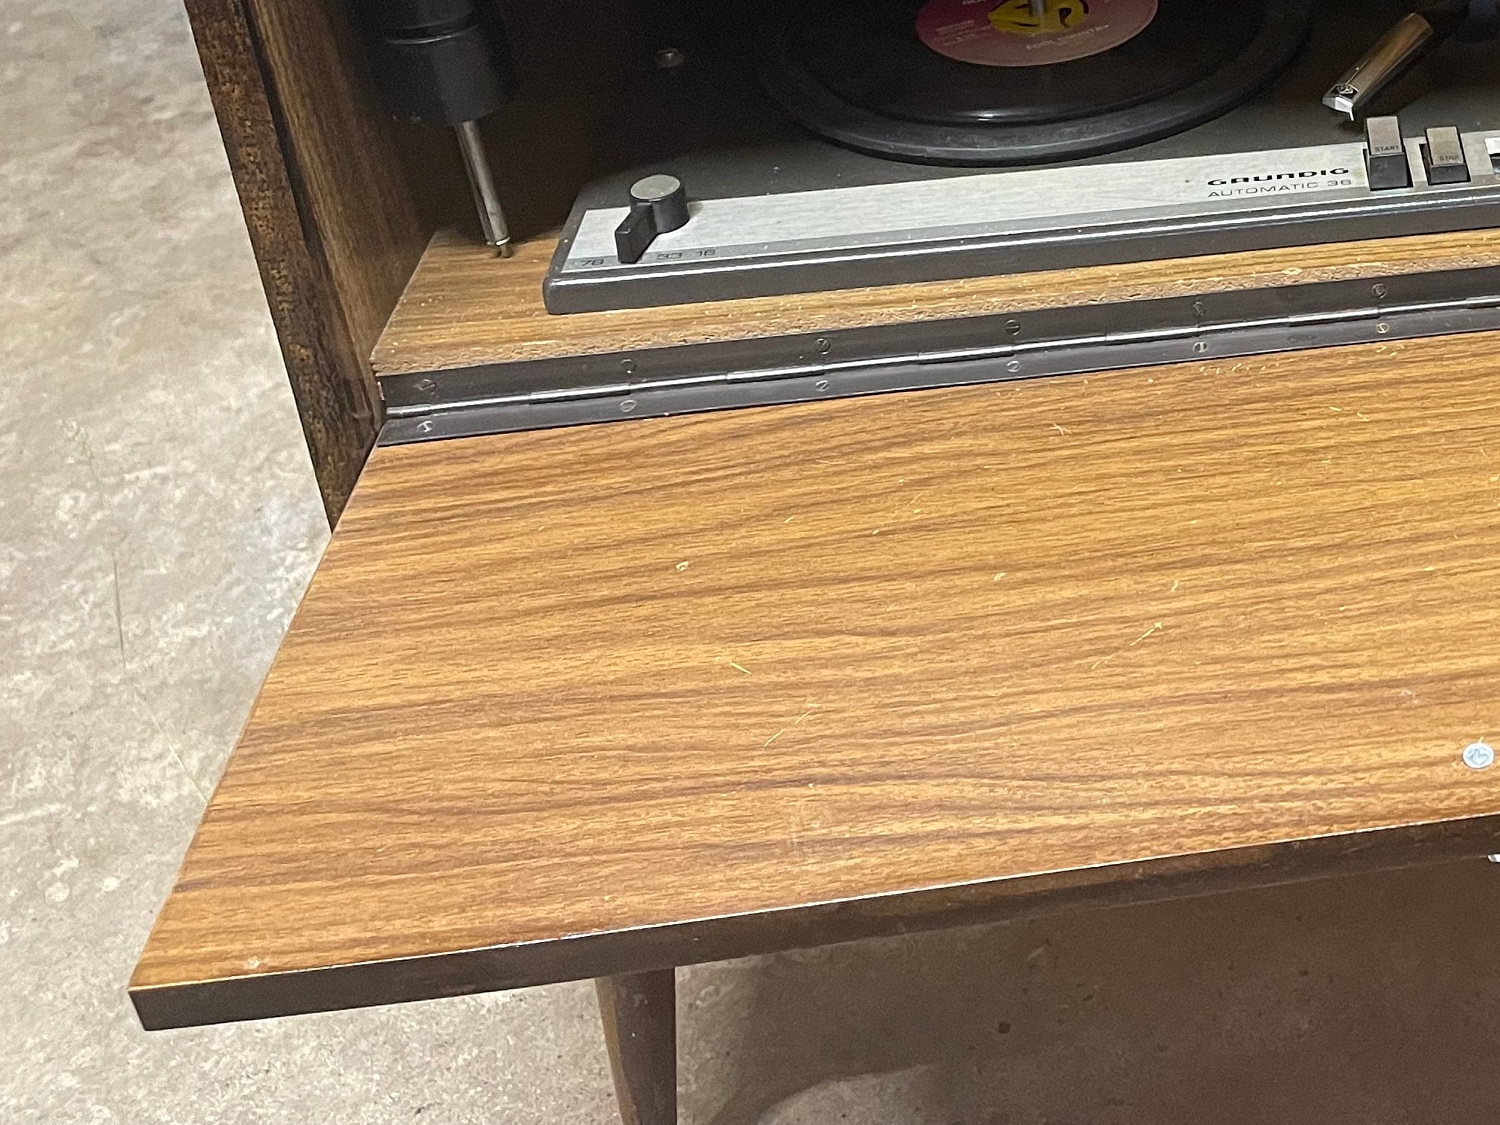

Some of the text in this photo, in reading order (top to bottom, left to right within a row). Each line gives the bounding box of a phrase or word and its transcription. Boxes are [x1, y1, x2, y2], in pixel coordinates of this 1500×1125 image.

[1374, 145, 1400, 153] START
[1206, 167, 1349, 186] GRUNDIG
[1207, 181, 1319, 197] AUTOMATIC
